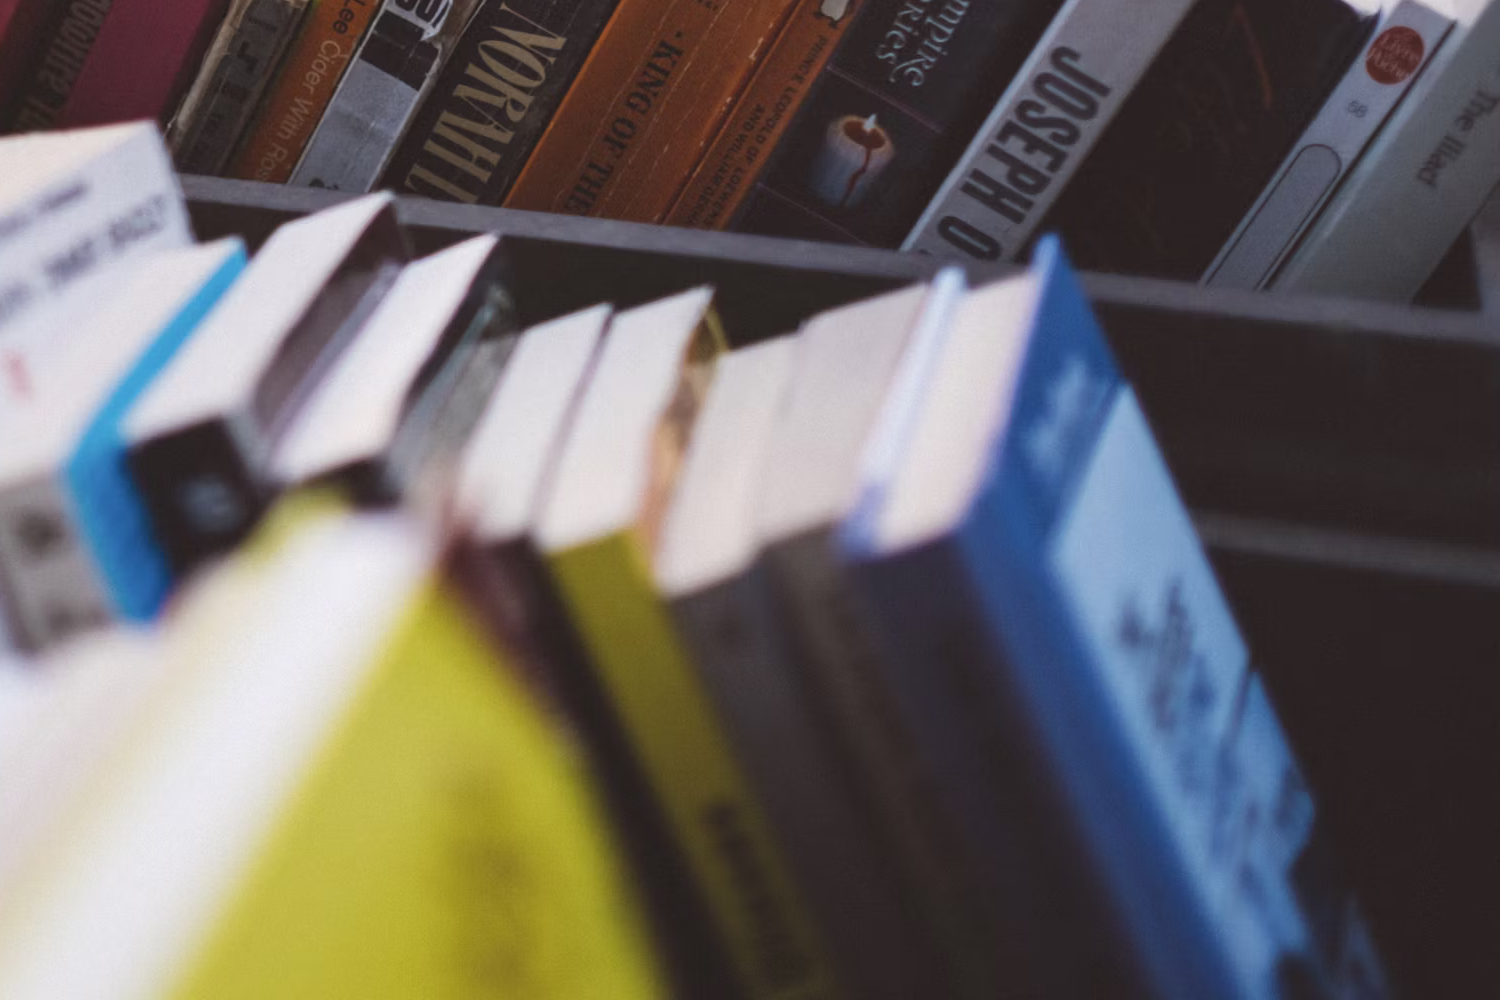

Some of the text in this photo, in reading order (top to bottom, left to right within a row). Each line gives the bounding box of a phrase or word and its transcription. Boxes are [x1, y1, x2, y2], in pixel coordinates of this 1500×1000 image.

[303, 39, 342, 93] Cider
[791, 34, 828, 84] PRINCE
[277, 93, 315, 141] With
[422, 1, 567, 184] NORAH
[744, 104, 766, 131] AND
[755, 85, 797, 145] LEOPOLD
[566, 39, 684, 216] KING OF THE
[961, 45, 1111, 225] JOSEPH
[1416, 87, 1500, 188] The Iliad
[711, 132, 748, 186] WILLIAM
